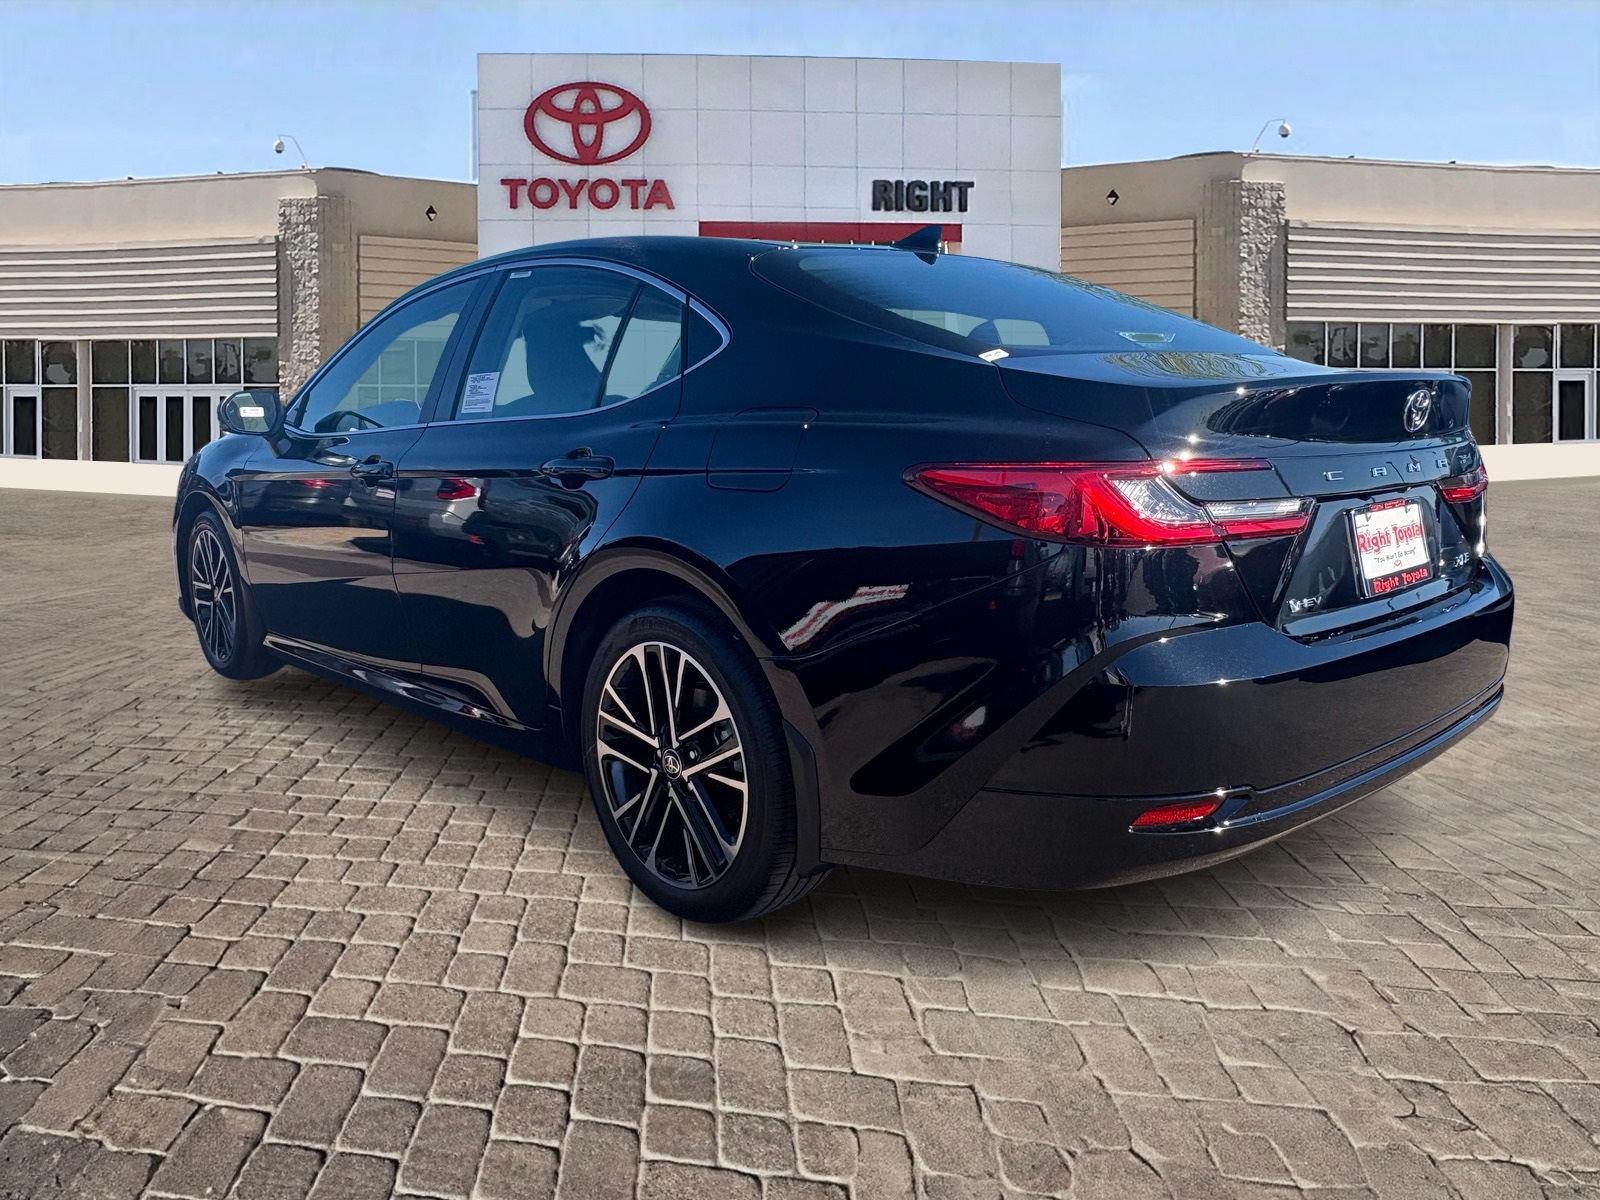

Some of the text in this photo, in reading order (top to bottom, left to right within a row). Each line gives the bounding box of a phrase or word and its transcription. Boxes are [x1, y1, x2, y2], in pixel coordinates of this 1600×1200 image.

[501, 180, 673, 209] TOYOTA
[872, 179, 975, 212] RIGHT
[1358, 523, 1423, 553] Right Toyota
[1373, 568, 1428, 594] Right Toyota
